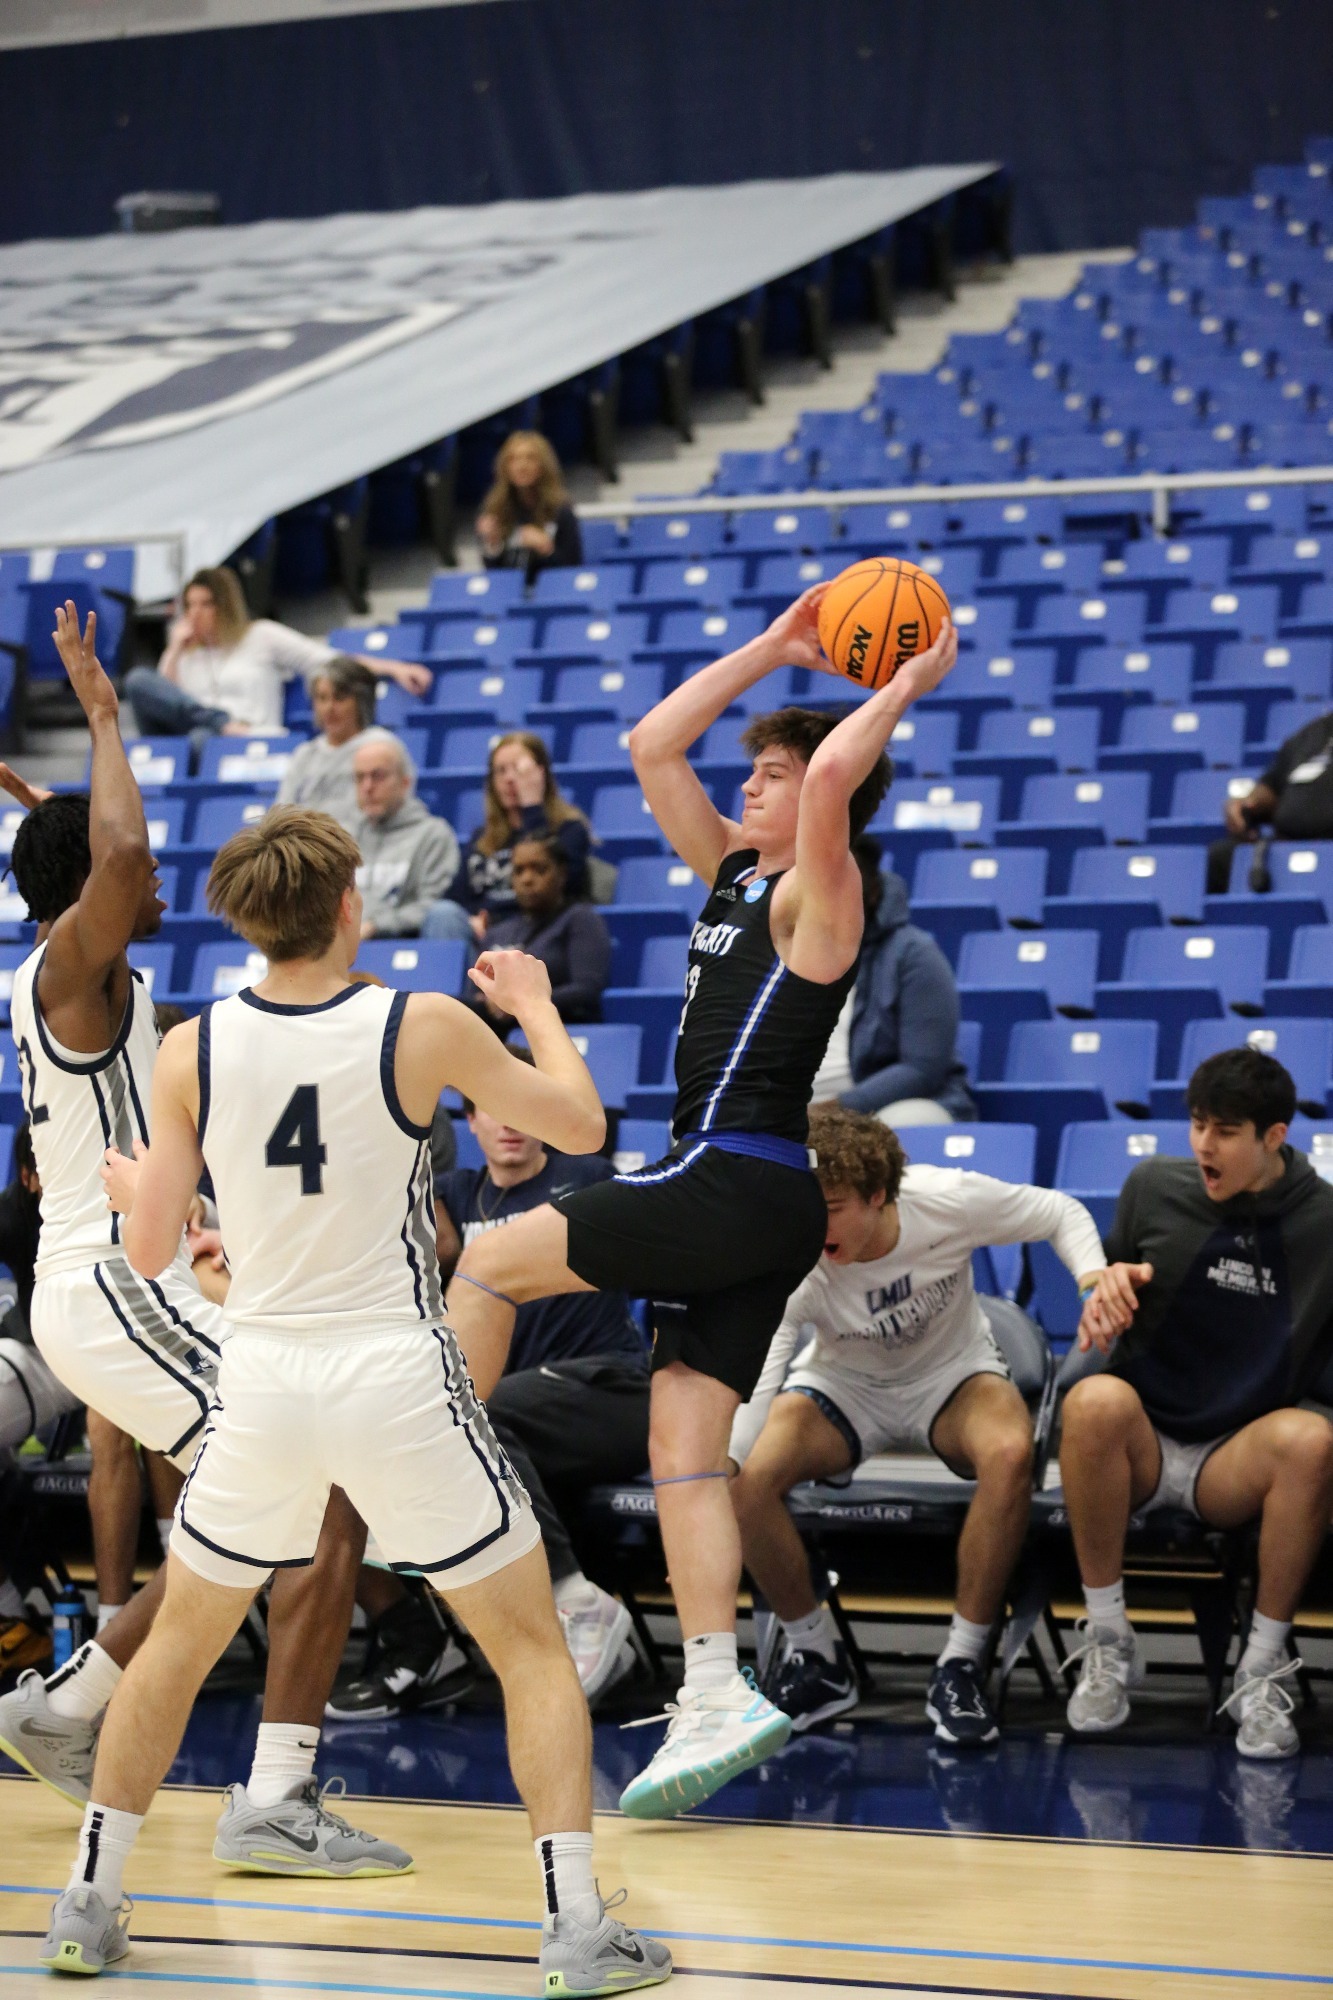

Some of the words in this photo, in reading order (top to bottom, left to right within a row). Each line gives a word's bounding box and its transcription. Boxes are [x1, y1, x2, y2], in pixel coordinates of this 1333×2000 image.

[846, 624, 873, 681] NCAA
[265, 1083, 327, 1196] 4
[33, 1475, 88, 1492] JAGUA
[611, 1493, 657, 1512] JAGU
